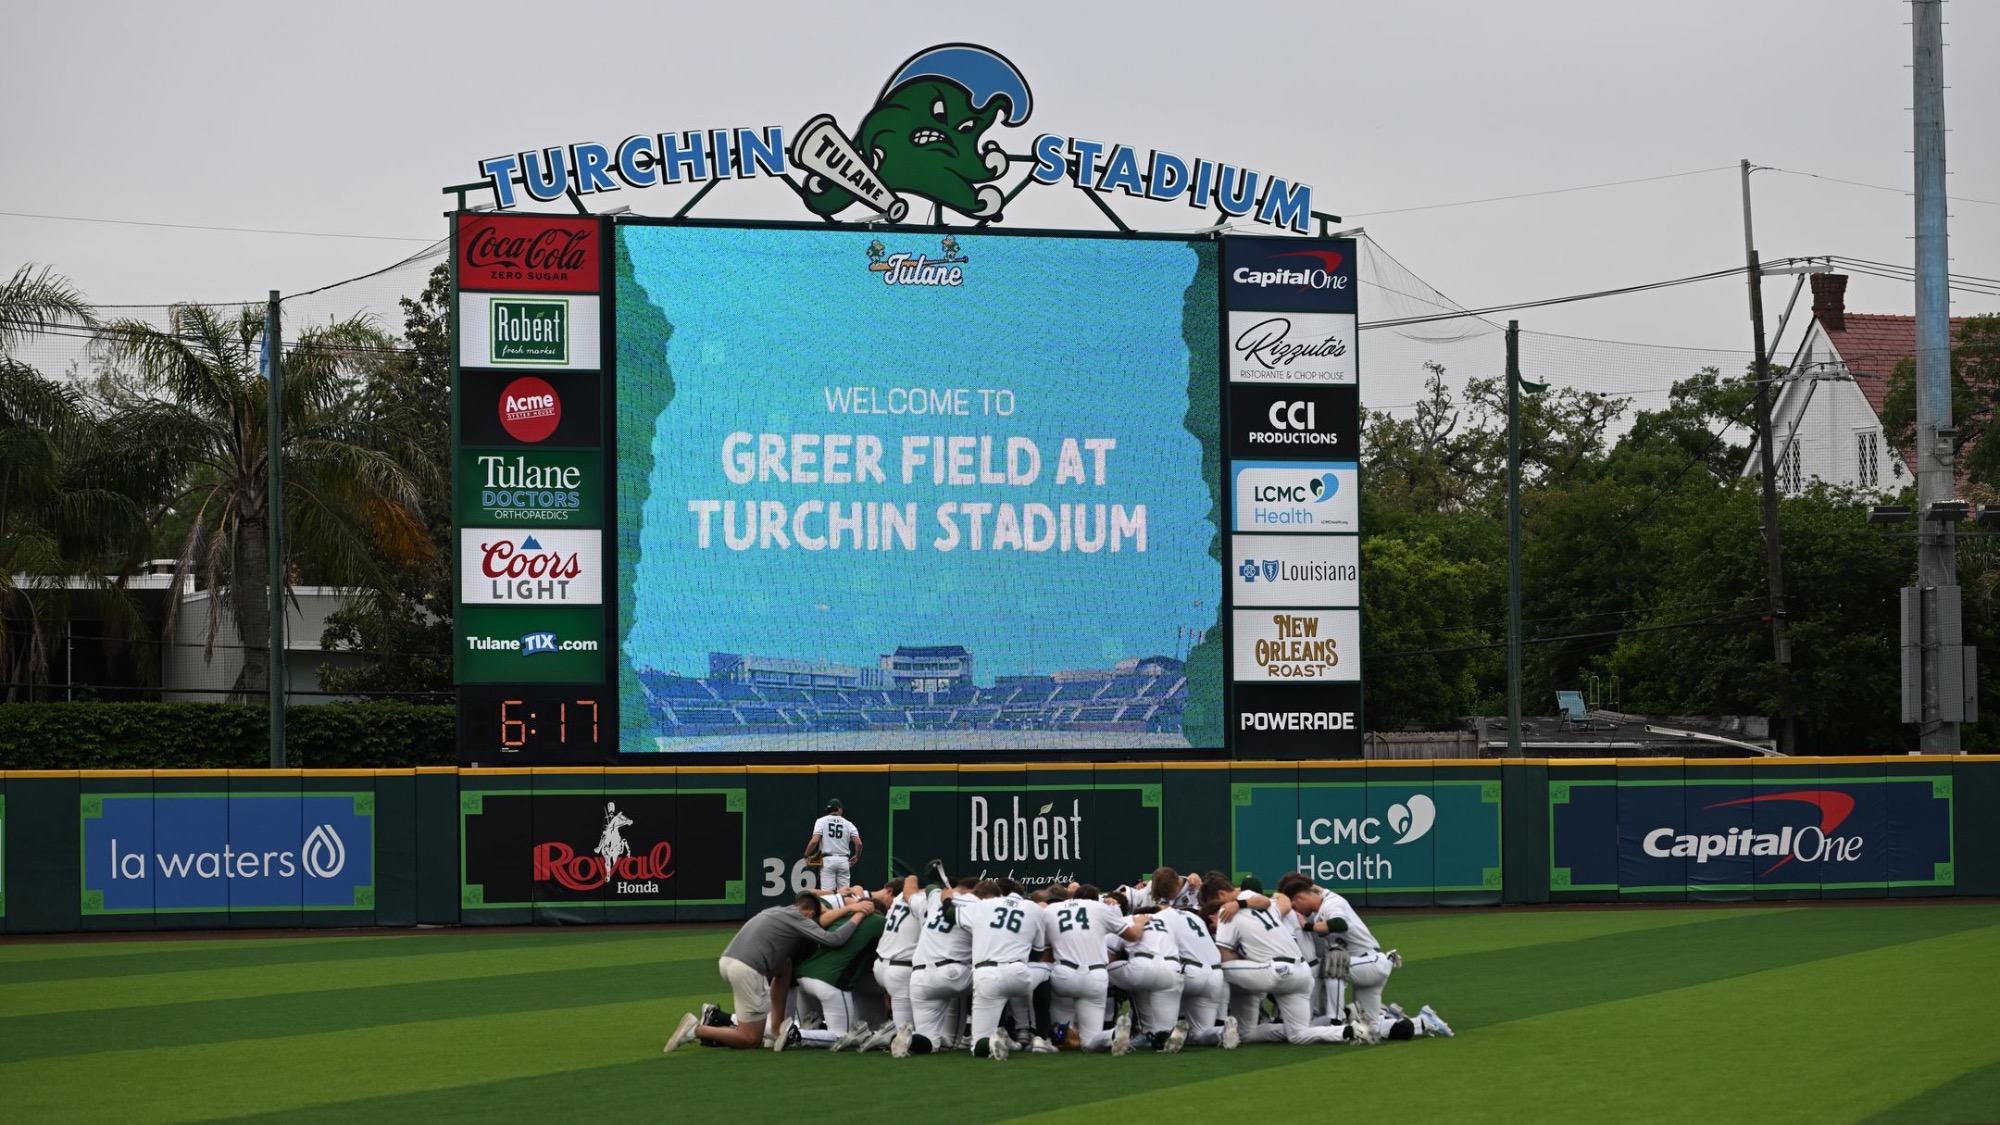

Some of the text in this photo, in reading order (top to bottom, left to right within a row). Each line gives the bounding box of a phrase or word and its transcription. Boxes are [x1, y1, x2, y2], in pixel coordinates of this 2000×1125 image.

[478, 126, 1314, 235] TURCHIN STADIUM
[814, 134, 884, 201] TULANE
[466, 226, 593, 271] Coca-Cola
[490, 271, 568, 281] ZERO SUGAR
[883, 252, 963, 287] Tulane
[502, 345, 556, 357] fresh market
[1235, 317, 1347, 370] Rizzuto's
[1240, 370, 1344, 380] RISTORANTE & CHOP HOUSE
[506, 394, 554, 413] Acme
[824, 386, 1015, 416] WELCOME TO
[1268, 400, 1316, 430] CCI
[1249, 432, 1338, 444] PRODUCTIONS
[478, 456, 581, 489] Tulane
[721, 432, 1116, 486] GREER FIELD AT
[482, 490, 580, 508] DOCTORS
[1254, 486, 1306, 502] LCMC
[494, 510, 569, 520] ORTHOPAEDICS
[688, 500, 1147, 553] TURCHIN STADIUM
[1255, 507, 1313, 524] Health
[480, 540, 582, 579] Coors
[1282, 560, 1357, 581] Louisiana
[492, 580, 570, 600] LIGHT
[1273, 614, 1319, 640] NEW
[1255, 638, 1339, 667] ORLEANS
[1268, 664, 1327, 677] ROAST
[502, 700, 598, 746] 6:17
[1240, 712, 1355, 730] POWERADE
[828, 823, 843, 839] 56
[1296, 818, 1381, 845] LCMC
[111, 838, 296, 880] la waters
[533, 841, 675, 891] Royal
[1296, 852, 1393, 881] Health
[617, 881, 659, 894] Honda
[1021, 868, 1075, 885] market
[989, 907, 1025, 934] 36
[1057, 907, 1090, 934] 24
[1186, 917, 1205, 937] 4
